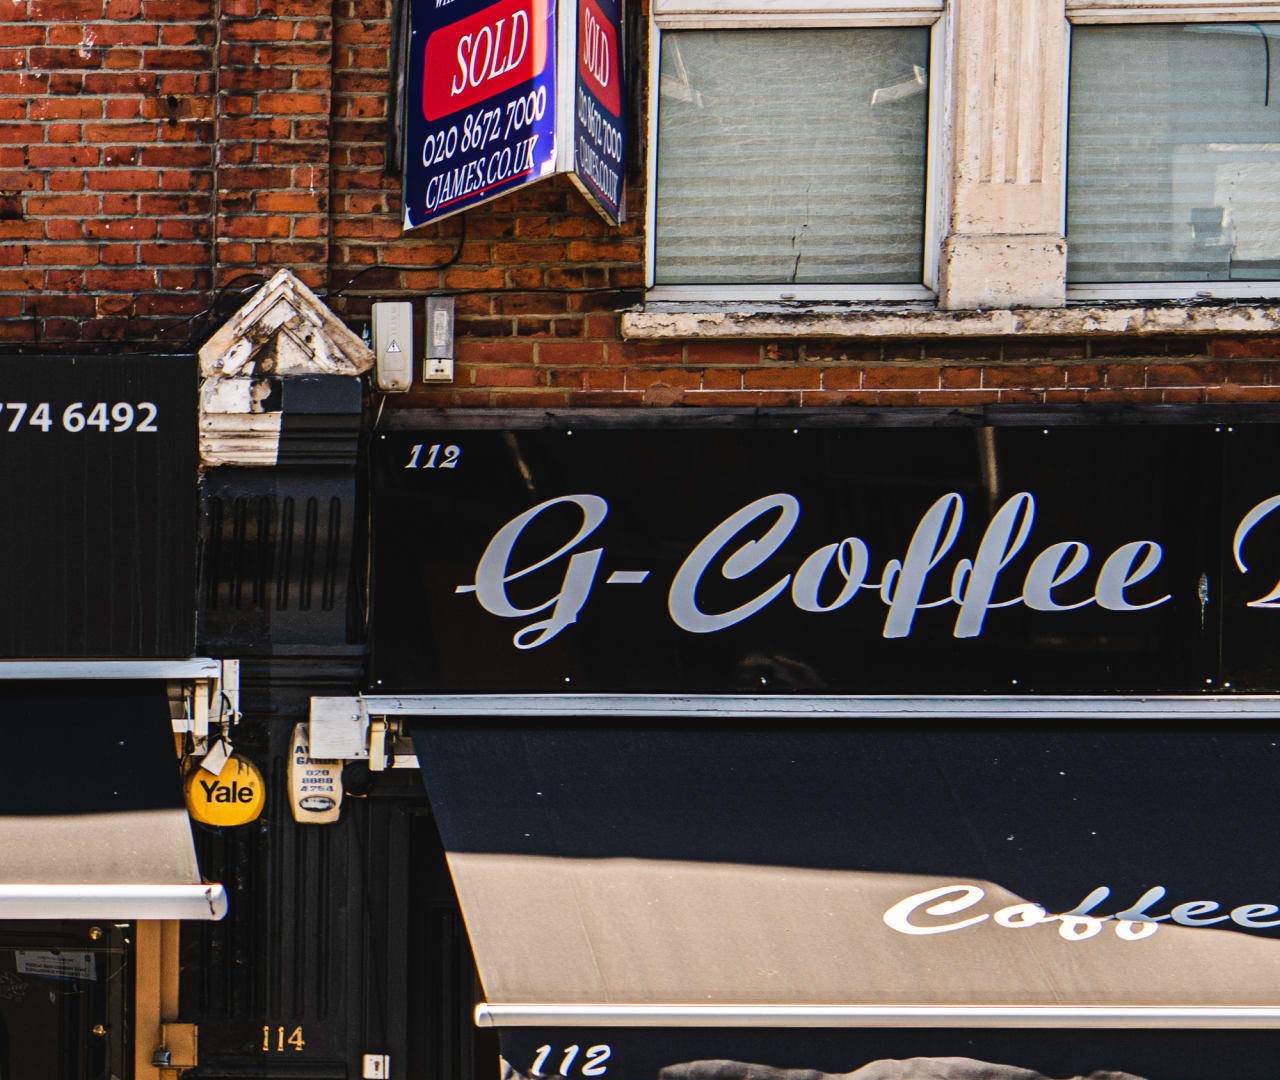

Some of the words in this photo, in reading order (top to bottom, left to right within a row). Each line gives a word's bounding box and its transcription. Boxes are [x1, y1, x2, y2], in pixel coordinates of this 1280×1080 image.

[451, 10, 529, 97] SOLD
[584, 7, 609, 88] SOLD
[423, 128, 457, 168] 020
[461, 106, 501, 154] 8672
[505, 86, 546, 140] 7000
[602, 119, 622, 163] 7000
[425, 134, 539, 210] CJAMES.CO.UK
[61, 402, 159, 433] 6492
[405, 444, 461, 469] 112
[200, 780, 254, 804] Yale
[883, 884, 1280, 941] Coffee
[262, 1026, 305, 1051] 114
[530, 1045, 611, 1078] 112
